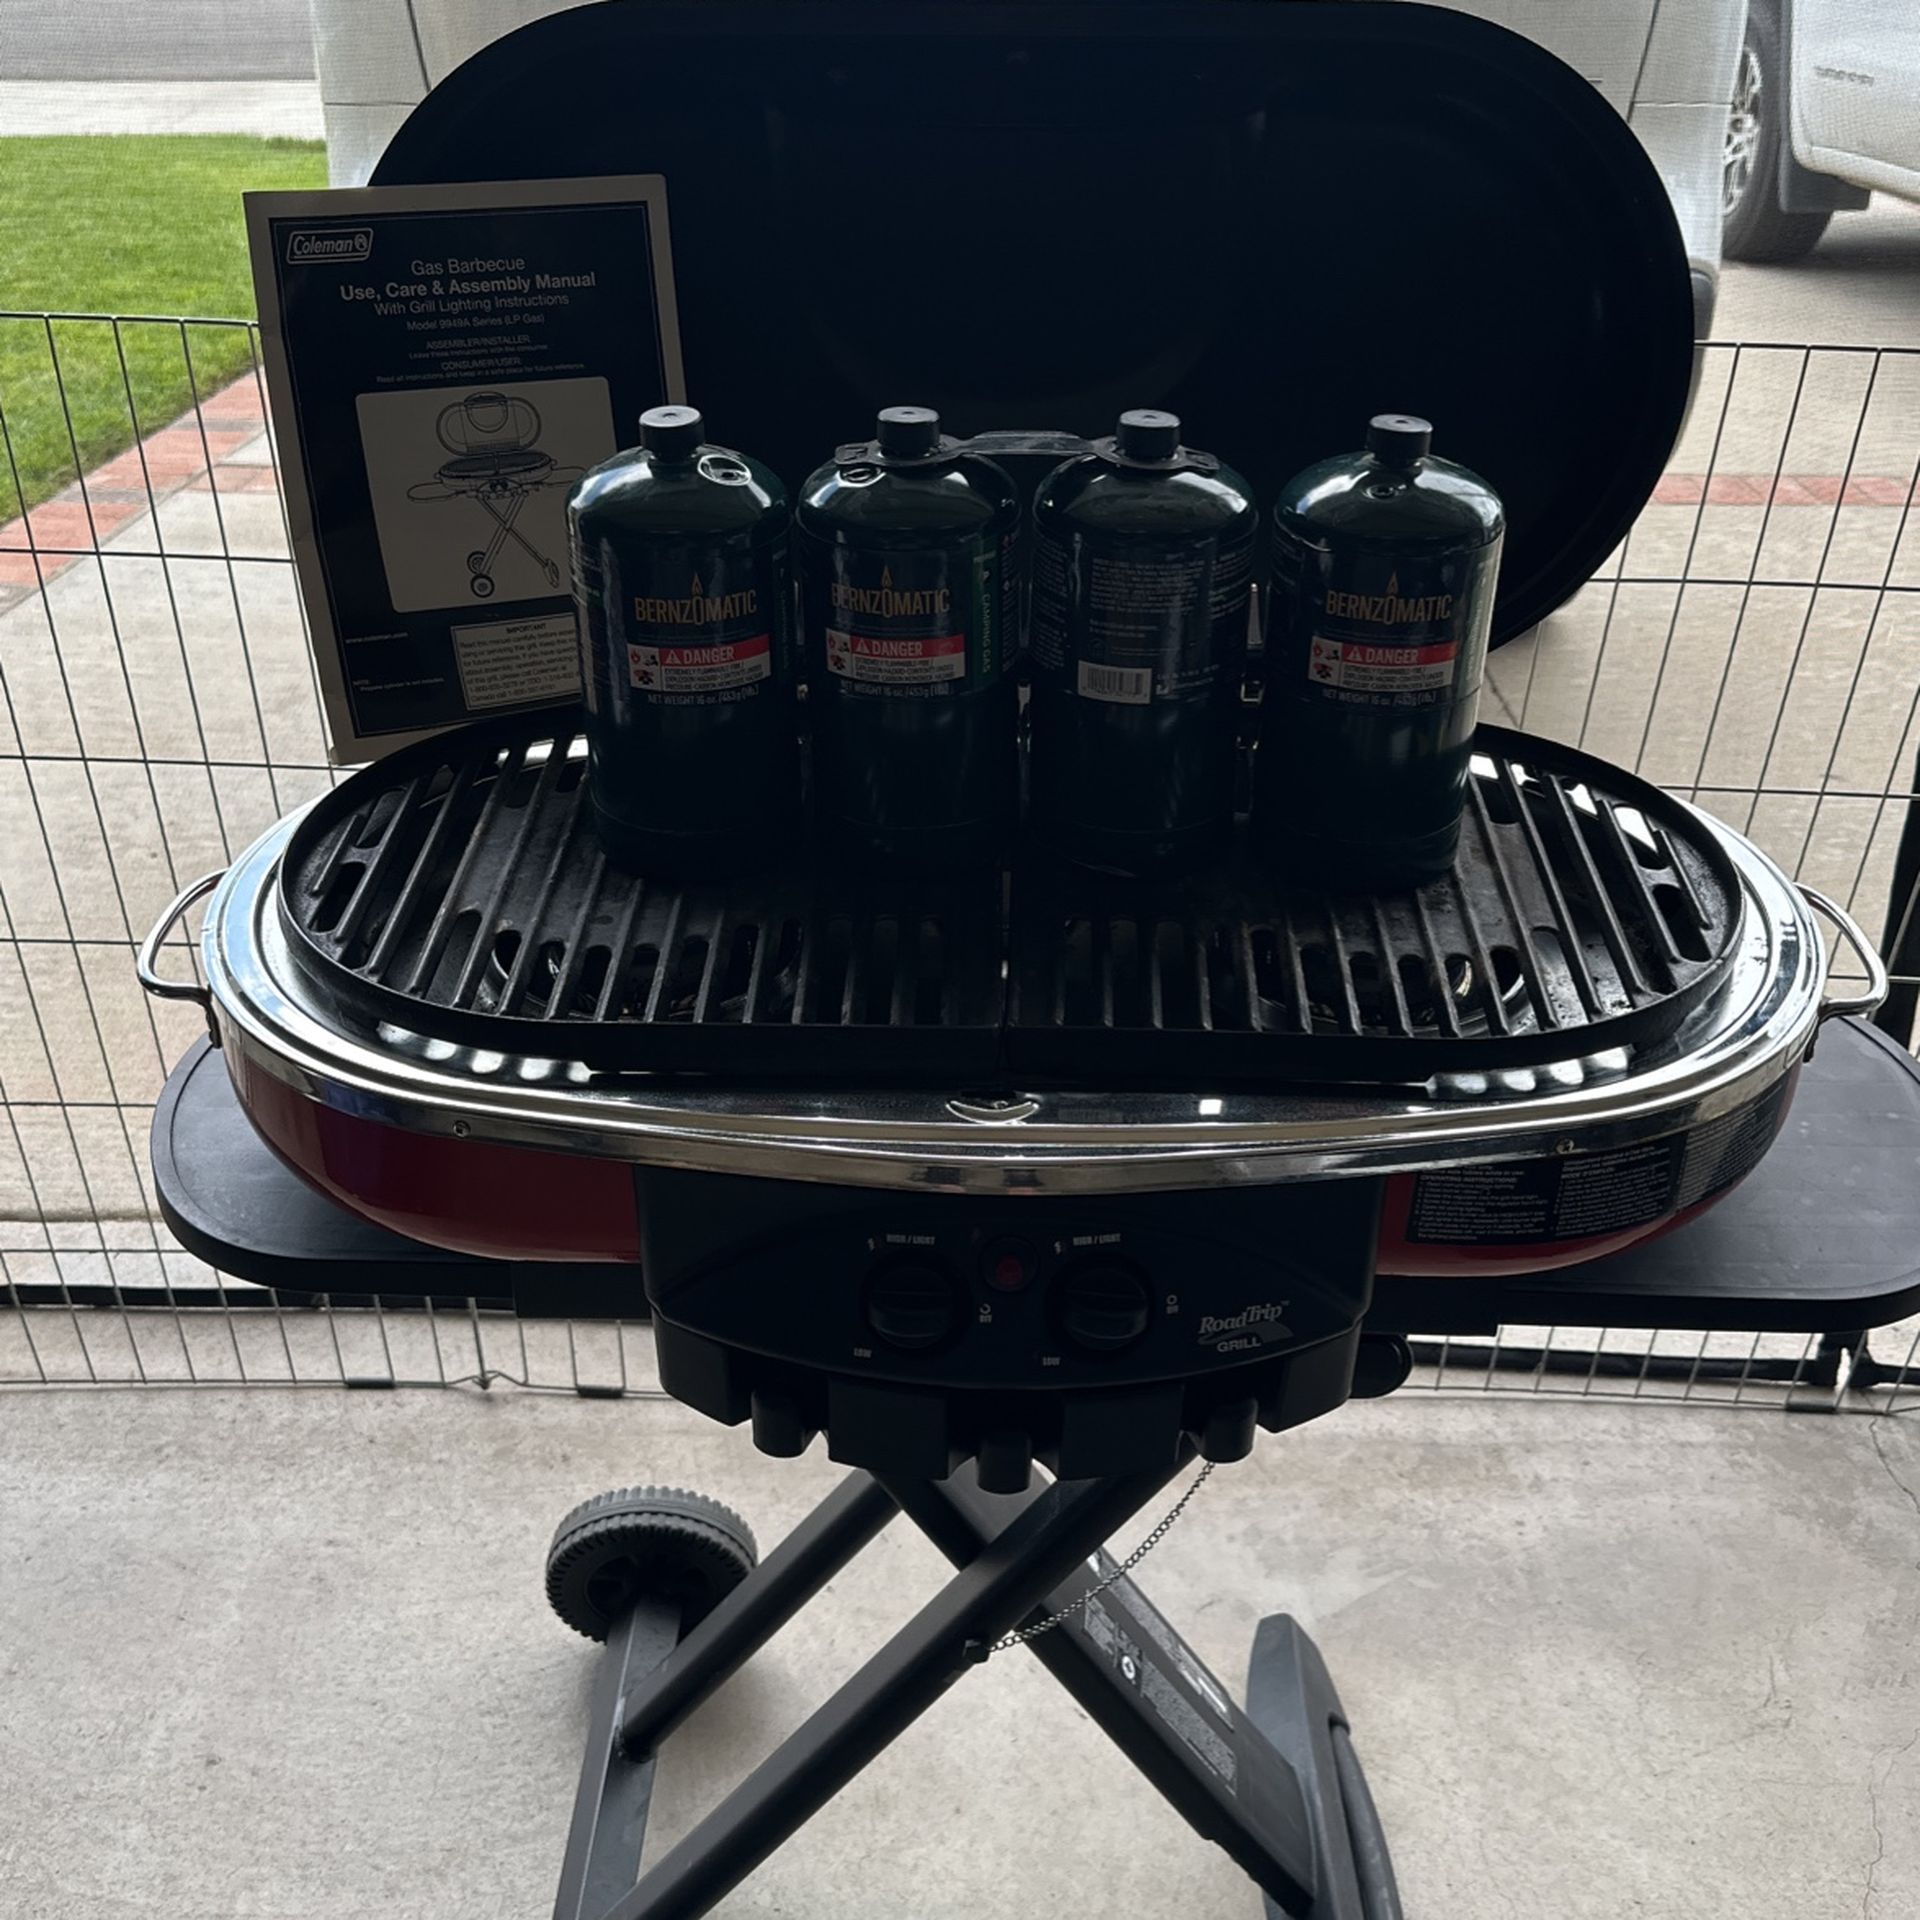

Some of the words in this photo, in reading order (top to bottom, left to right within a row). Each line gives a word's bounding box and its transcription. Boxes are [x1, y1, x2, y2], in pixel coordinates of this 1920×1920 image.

[293, 235, 353, 255] Coleman
[411, 259, 444, 276] Gas
[447, 257, 526, 275] Barbecue
[340, 285, 381, 301] Use,
[385, 282, 427, 298] Care
[432, 280, 445, 296] &
[449, 275, 531, 295] Assembly
[535, 271, 596, 289] Manual
[374, 302, 406, 316] With
[409, 300, 436, 314] Grill
[439, 299, 492, 315] Lighting
[494, 294, 570, 308] Instructions
[406, 320, 438, 332] Model
[473, 316, 502, 328] Series
[523, 313, 546, 325] Gas)
[634, 589, 757, 625] BERNZOMATIC
[832, 582, 950, 618] BERNZOMATIC
[1326, 589, 1453, 625] BERNZOMATIC
[982, 593, 992, 648] CAMPING
[683, 646, 735, 665] DANGER
[872, 640, 923, 656] DANGER
[1365, 648, 1419, 665] DANGER
[664, 694, 693, 705] WEIGHT
[885, 1232, 907, 1244] HIGH
[912, 1234, 936, 1246] LIGHT
[1072, 1235, 1093, 1246] HIGH
[1098, 1233, 1121, 1244] LIGHT
[853, 1347, 873, 1358] LOW
[1216, 1336, 1263, 1352] GRILL
[1042, 1355, 1062, 1367] LOW
